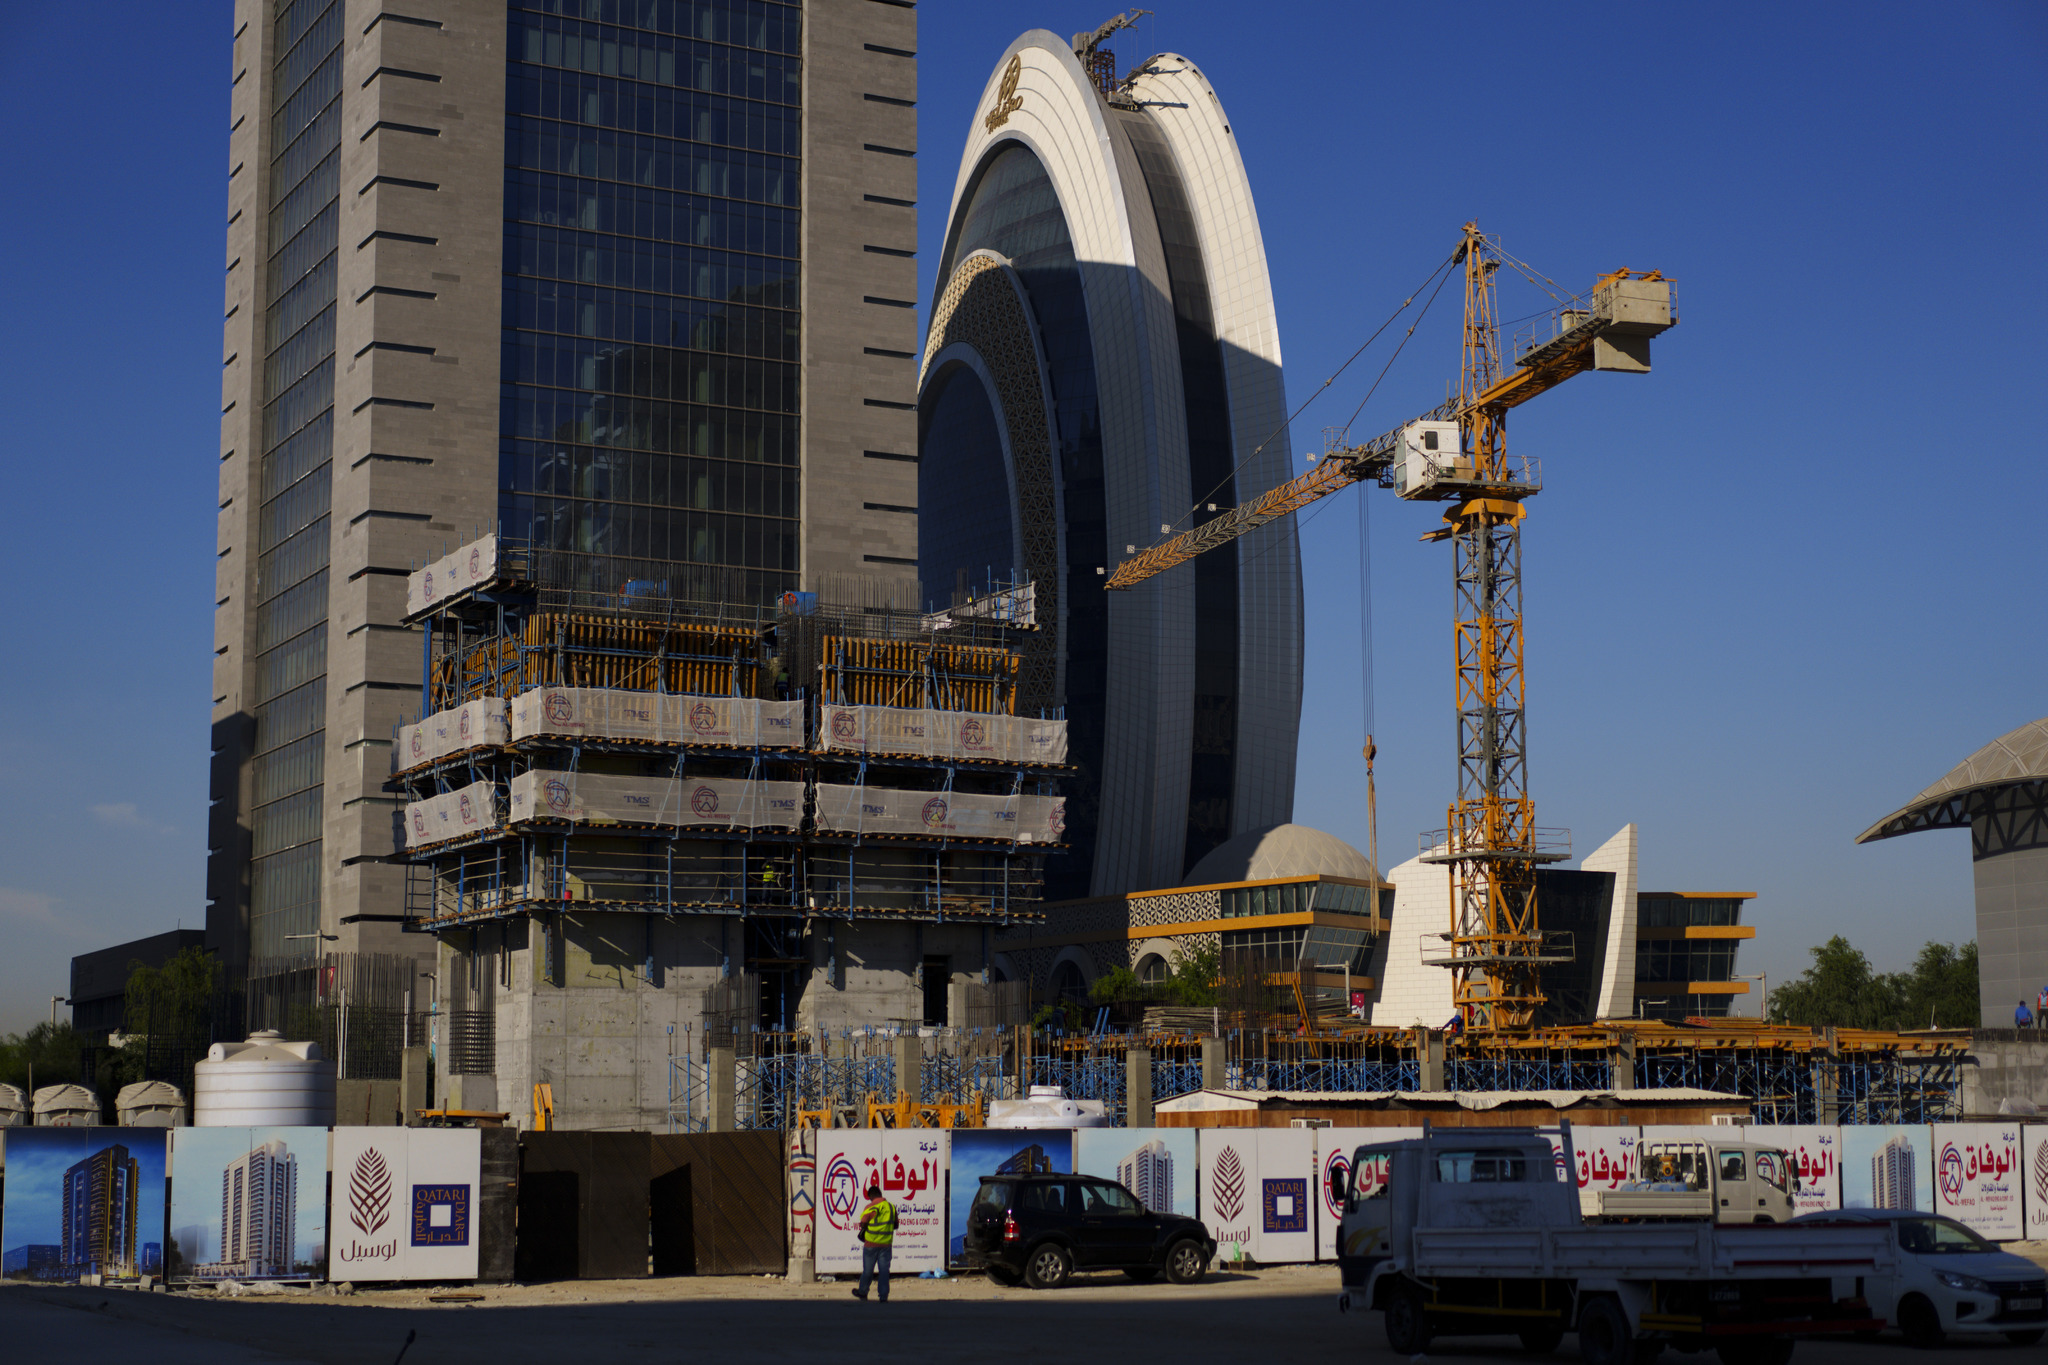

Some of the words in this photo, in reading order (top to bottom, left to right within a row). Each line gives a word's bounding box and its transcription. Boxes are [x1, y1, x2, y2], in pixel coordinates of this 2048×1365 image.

[767, 718, 791, 726] TMS
[624, 795, 650, 804] TMS
[771, 800, 795, 809] TMS
[863, 804, 885, 814] TMS
[994, 811, 1016, 819] TMS
[919, 1141, 938, 1153] شركة
[1619, 1136, 1634, 1147] شركة
[1966, 1143, 2015, 1181] الوفاق
[1577, 1148, 1634, 1189] الوفاق
[863, 1154, 937, 1200] الوفاق
[1265, 1182, 1303, 1195] QATARI
[416, 1189, 465, 1203] QATARI
[843, 1222, 862, 1231] AL-WE
[340, 1239, 397, 1262] لوسيل
